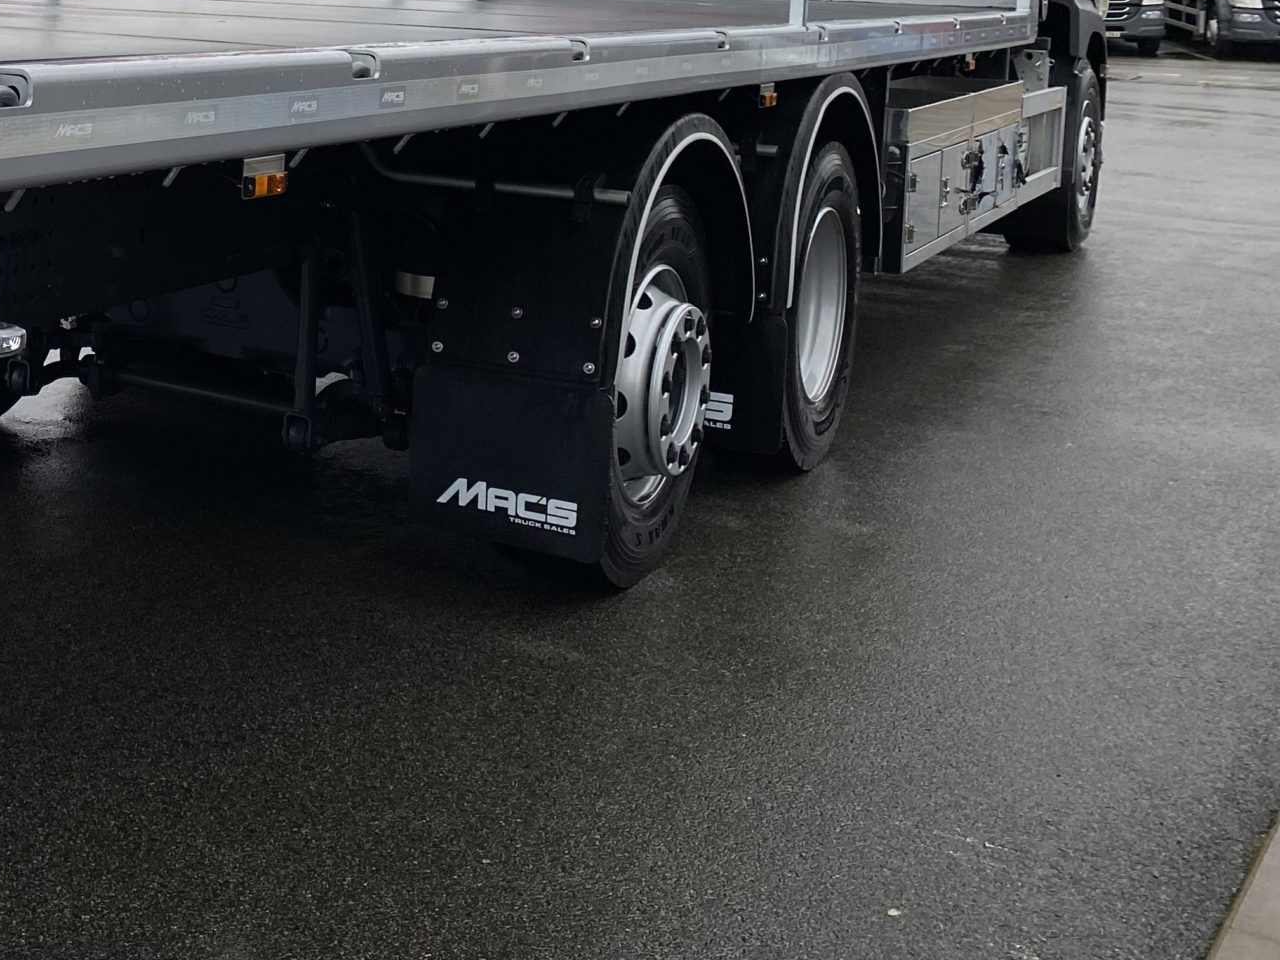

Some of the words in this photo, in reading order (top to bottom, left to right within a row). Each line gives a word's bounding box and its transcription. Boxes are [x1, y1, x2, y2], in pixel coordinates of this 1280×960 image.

[704, 421, 731, 430] ALES
[509, 516, 541, 530] TRUCK
[544, 523, 576, 536] SALES
